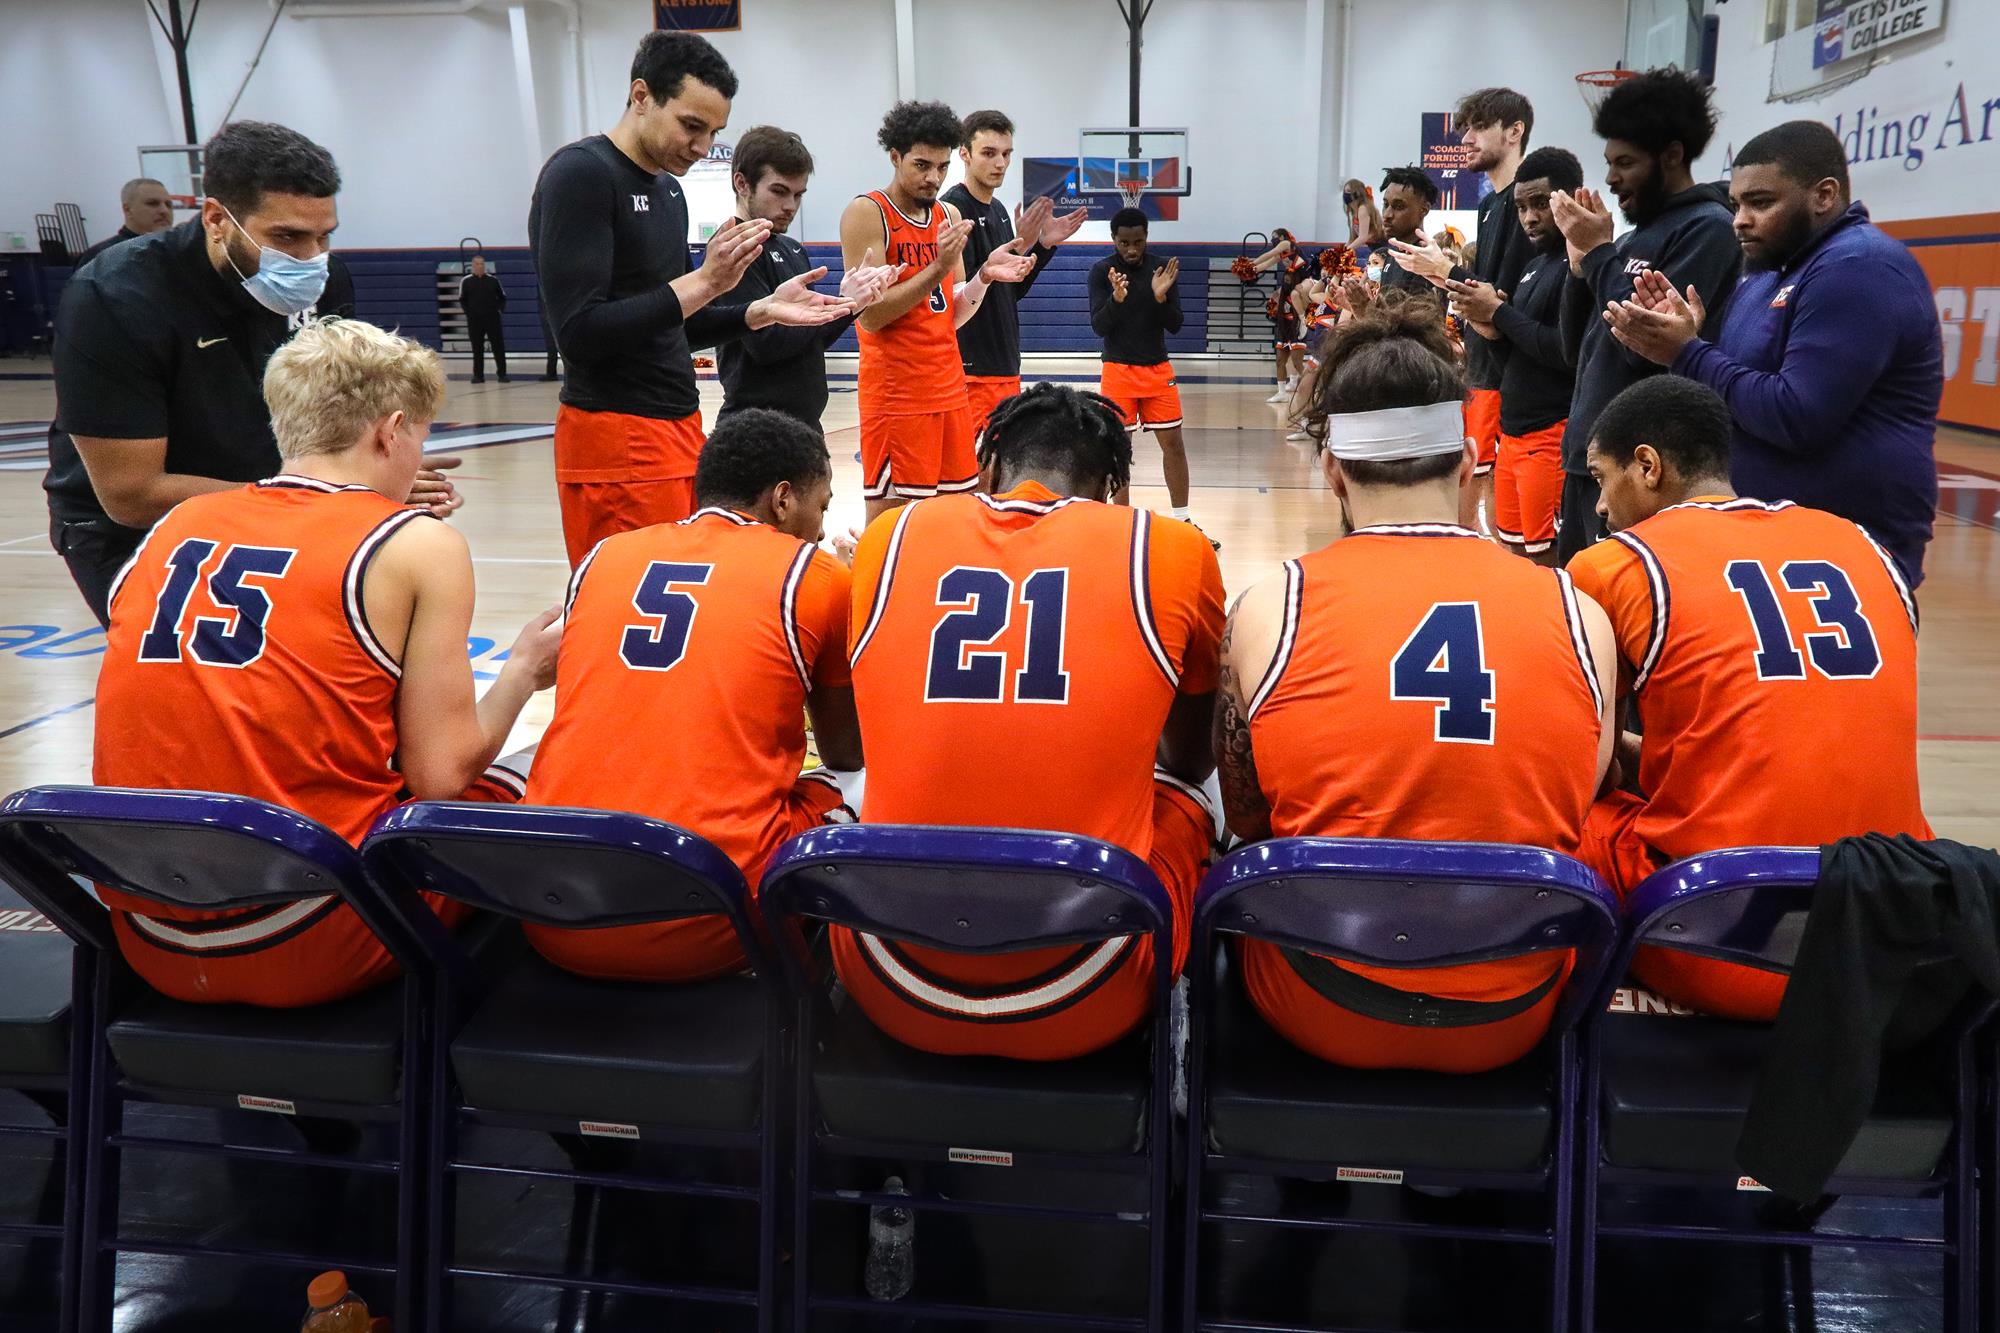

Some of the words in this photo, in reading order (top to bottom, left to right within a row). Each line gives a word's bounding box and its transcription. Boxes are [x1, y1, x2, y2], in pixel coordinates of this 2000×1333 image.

[1847, 0, 1922, 31] KEYST
[1851, 6, 1927, 50] COLLEGE
[1834, 106, 1931, 172] lding
[1441, 169, 1458, 178] KC
[631, 194, 650, 211] KC
[1060, 197, 1087, 205] Division
[897, 242, 938, 267] KEYST
[1623, 258, 1650, 275] KC
[137, 537, 299, 669] 15
[618, 560, 716, 672] 5
[1723, 558, 1884, 681] 13
[923, 565, 1071, 705] 21
[1389, 600, 1496, 746] 4
[1338, 1169, 1402, 1180] STADIUMCHAIR
